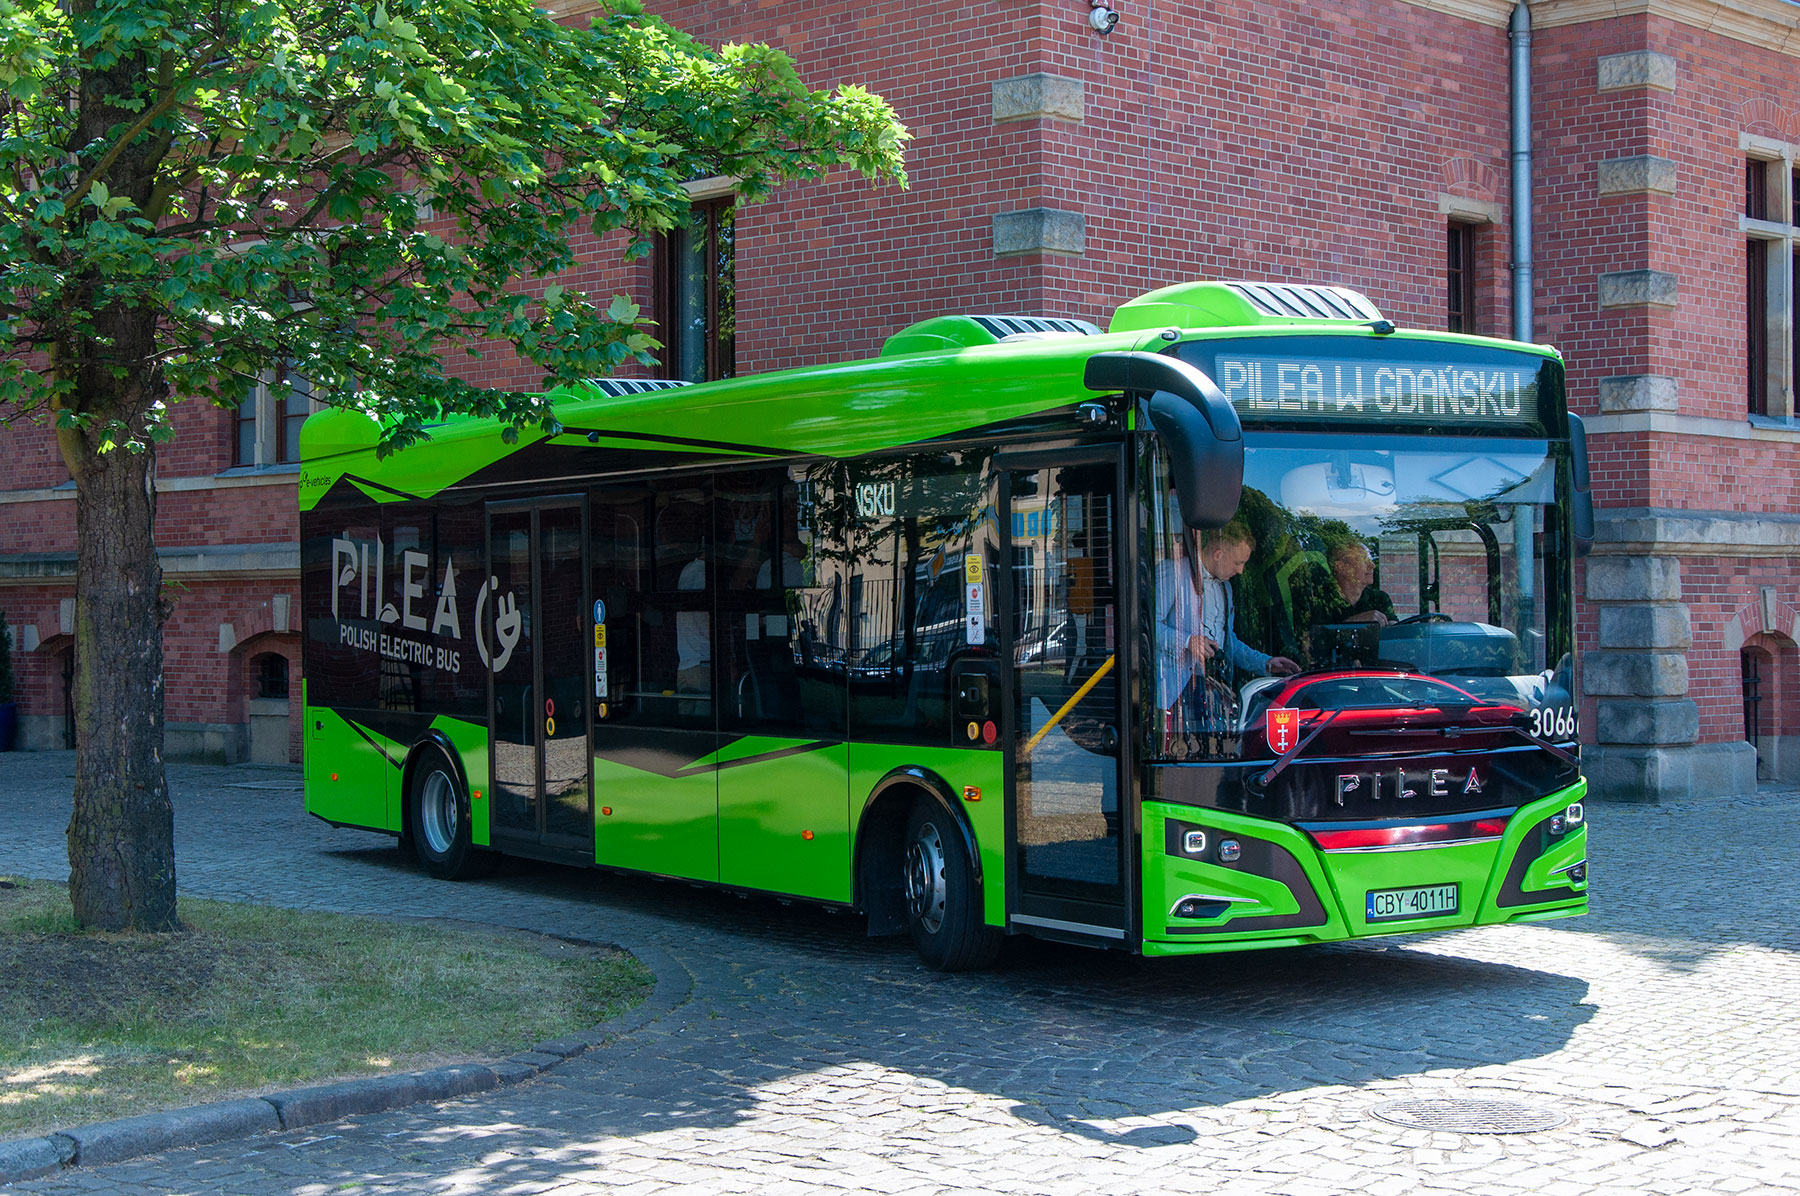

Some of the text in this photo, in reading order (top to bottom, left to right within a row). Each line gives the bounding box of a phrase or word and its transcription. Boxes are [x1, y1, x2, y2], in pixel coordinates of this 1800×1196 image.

[1224, 361, 1520, 416] PILEA W GDAŃSKU
[332, 531, 462, 640] PILEA
[340, 623, 461, 674] POLISH ELECTRIC BUS
[1529, 705, 1579, 738] 3066
[1335, 766, 1482, 807] PILEA
[1375, 887, 1456, 915] CBY 4011H
